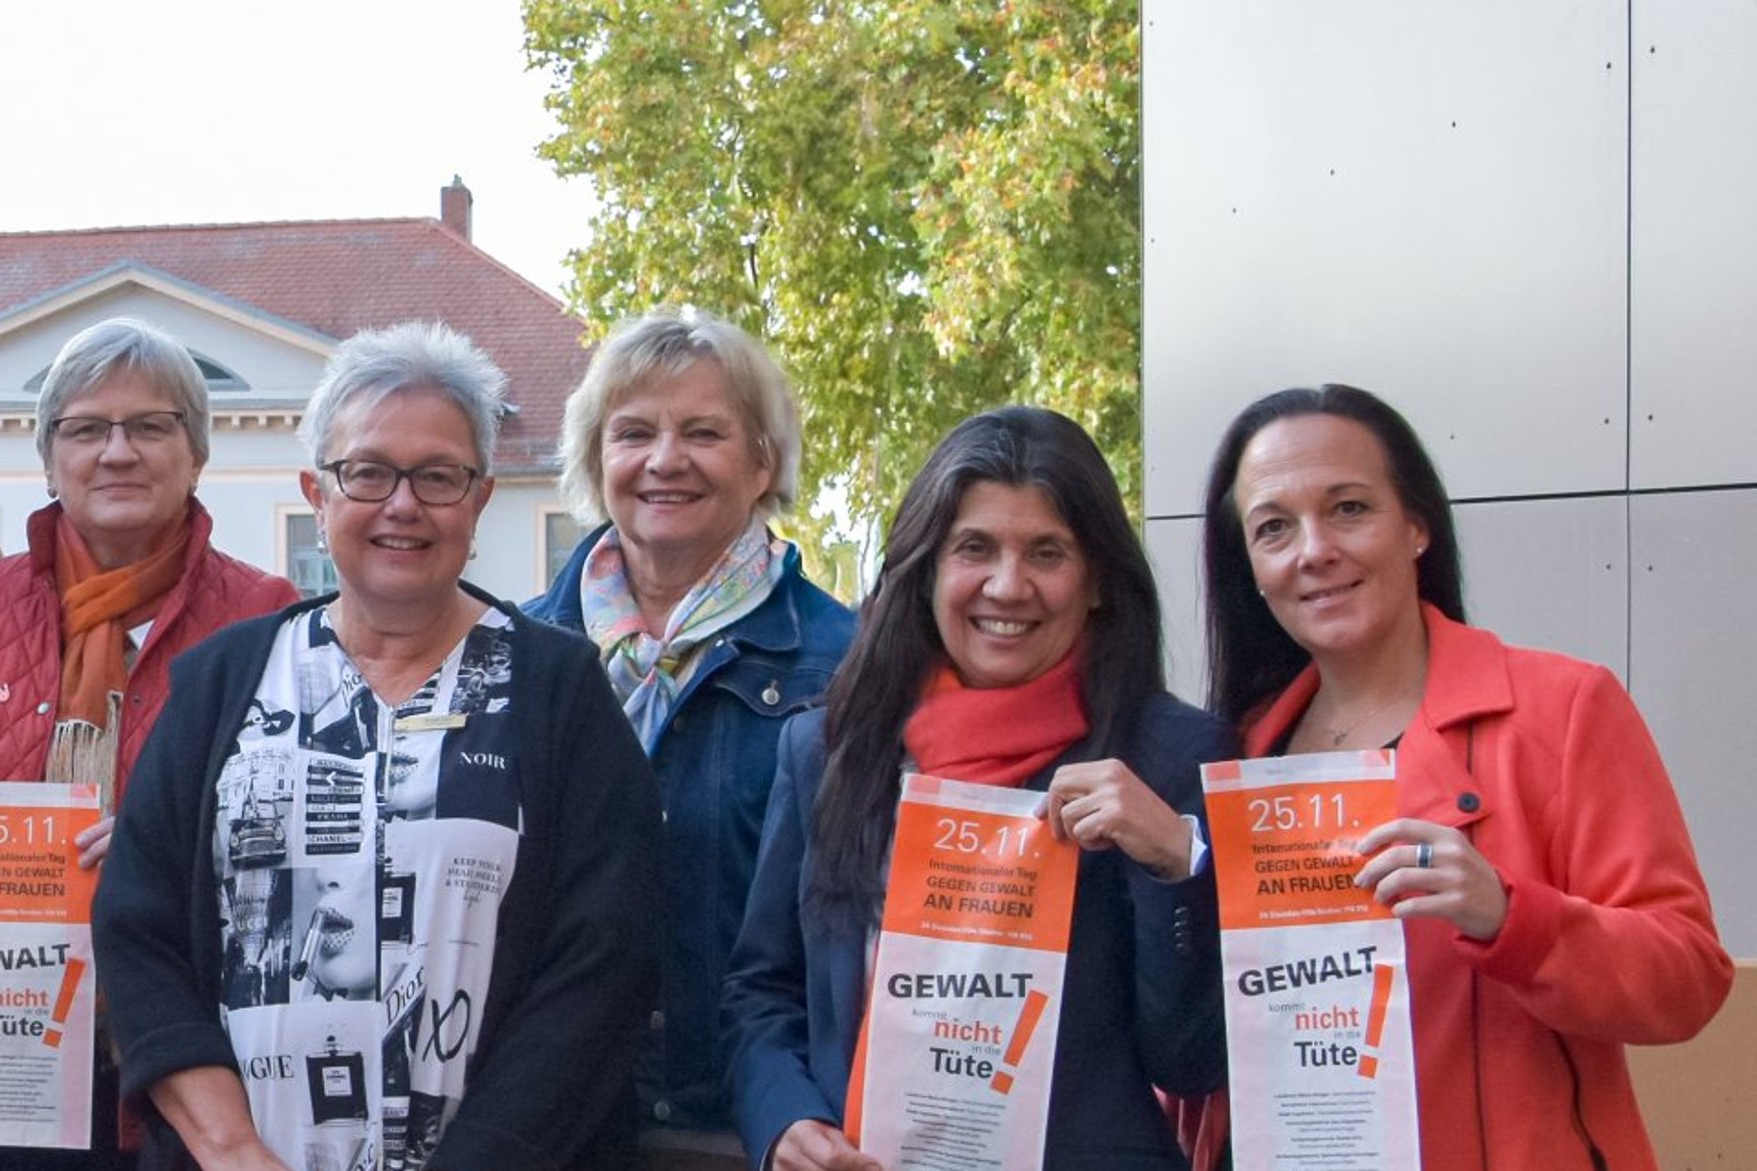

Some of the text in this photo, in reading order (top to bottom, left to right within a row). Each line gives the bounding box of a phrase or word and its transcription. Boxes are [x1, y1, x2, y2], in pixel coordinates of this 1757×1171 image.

[459, 751, 506, 770] NOIR
[1247, 793, 1360, 832] 25.11.
[933, 818, 1041, 859] 25.11.
[14, 866, 66, 878] GEWALT
[1254, 856, 1354, 874] GEGEN GEWALT
[926, 875, 1037, 897] GEGEN GEWALT
[1257, 878, 1286, 895] AN
[924, 893, 1034, 918] AN FRAUEN
[1237, 946, 1378, 996] GEWALT
[385, 965, 425, 1024] Dior
[887, 973, 1034, 999] GEWALT
[1295, 1006, 1360, 1030] nicht
[934, 1018, 1003, 1045] nicht
[929, 1047, 994, 1079] Tüte
[1294, 1040, 1358, 1067] Tüte
